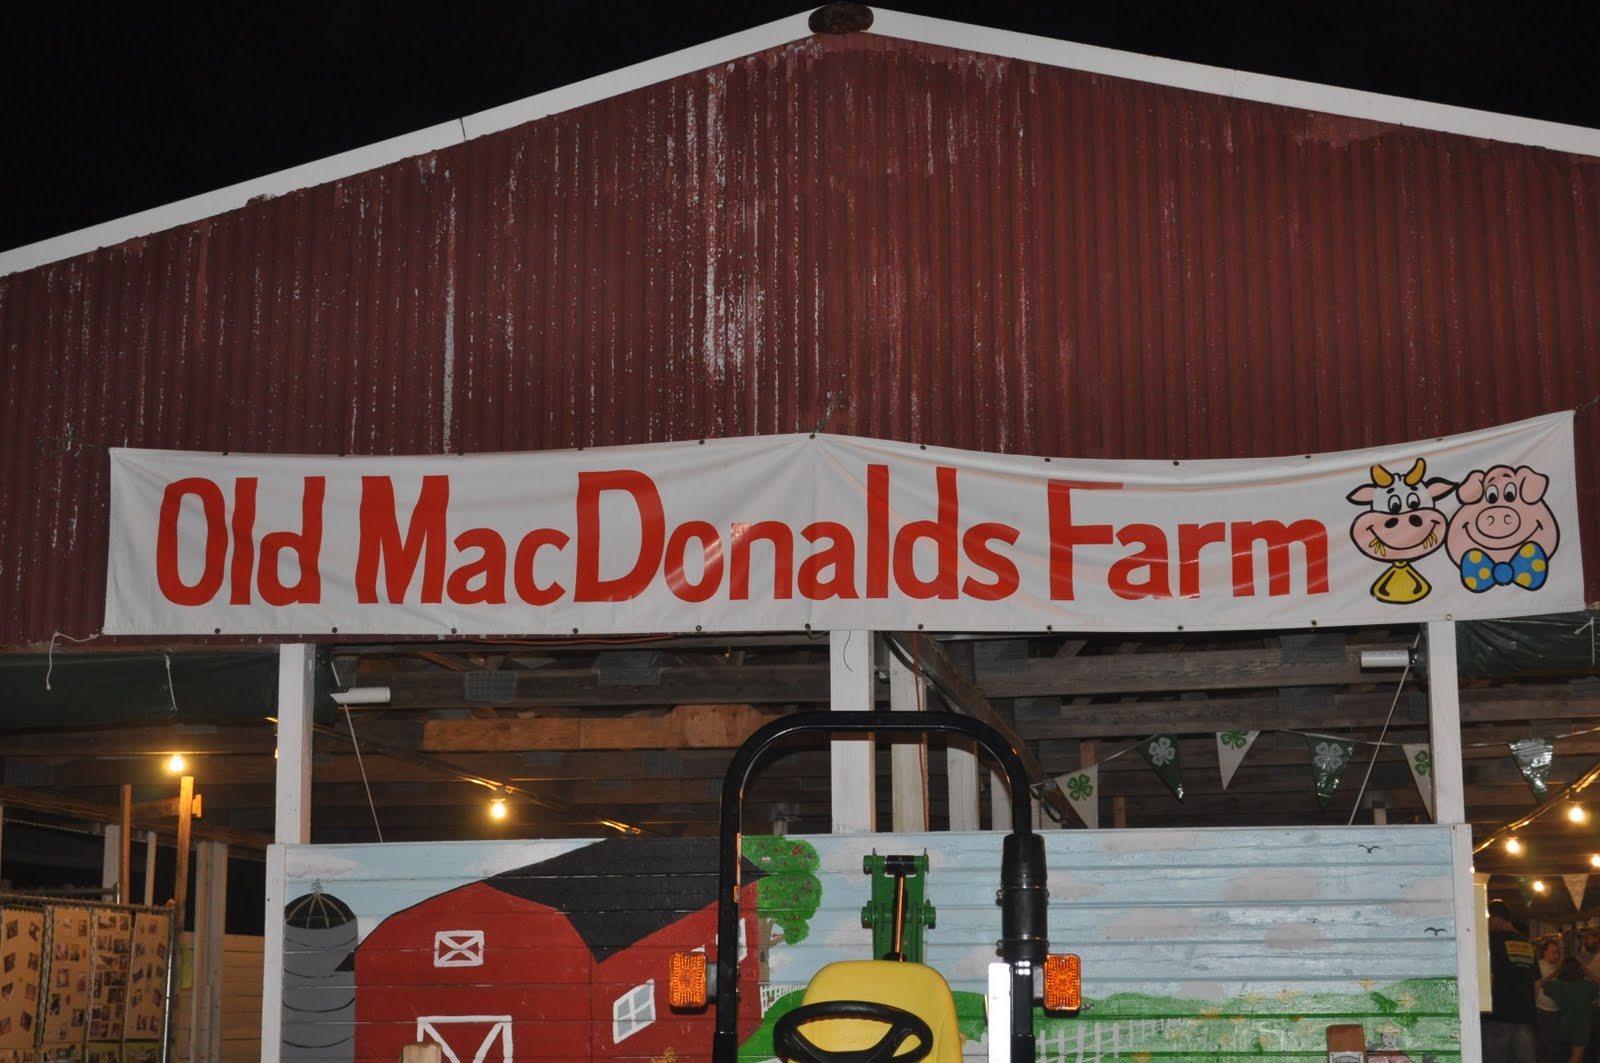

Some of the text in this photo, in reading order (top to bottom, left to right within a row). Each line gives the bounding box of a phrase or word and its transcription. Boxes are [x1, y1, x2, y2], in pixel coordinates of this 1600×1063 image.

[157, 464, 1330, 607] Old MacDonalds Farm
